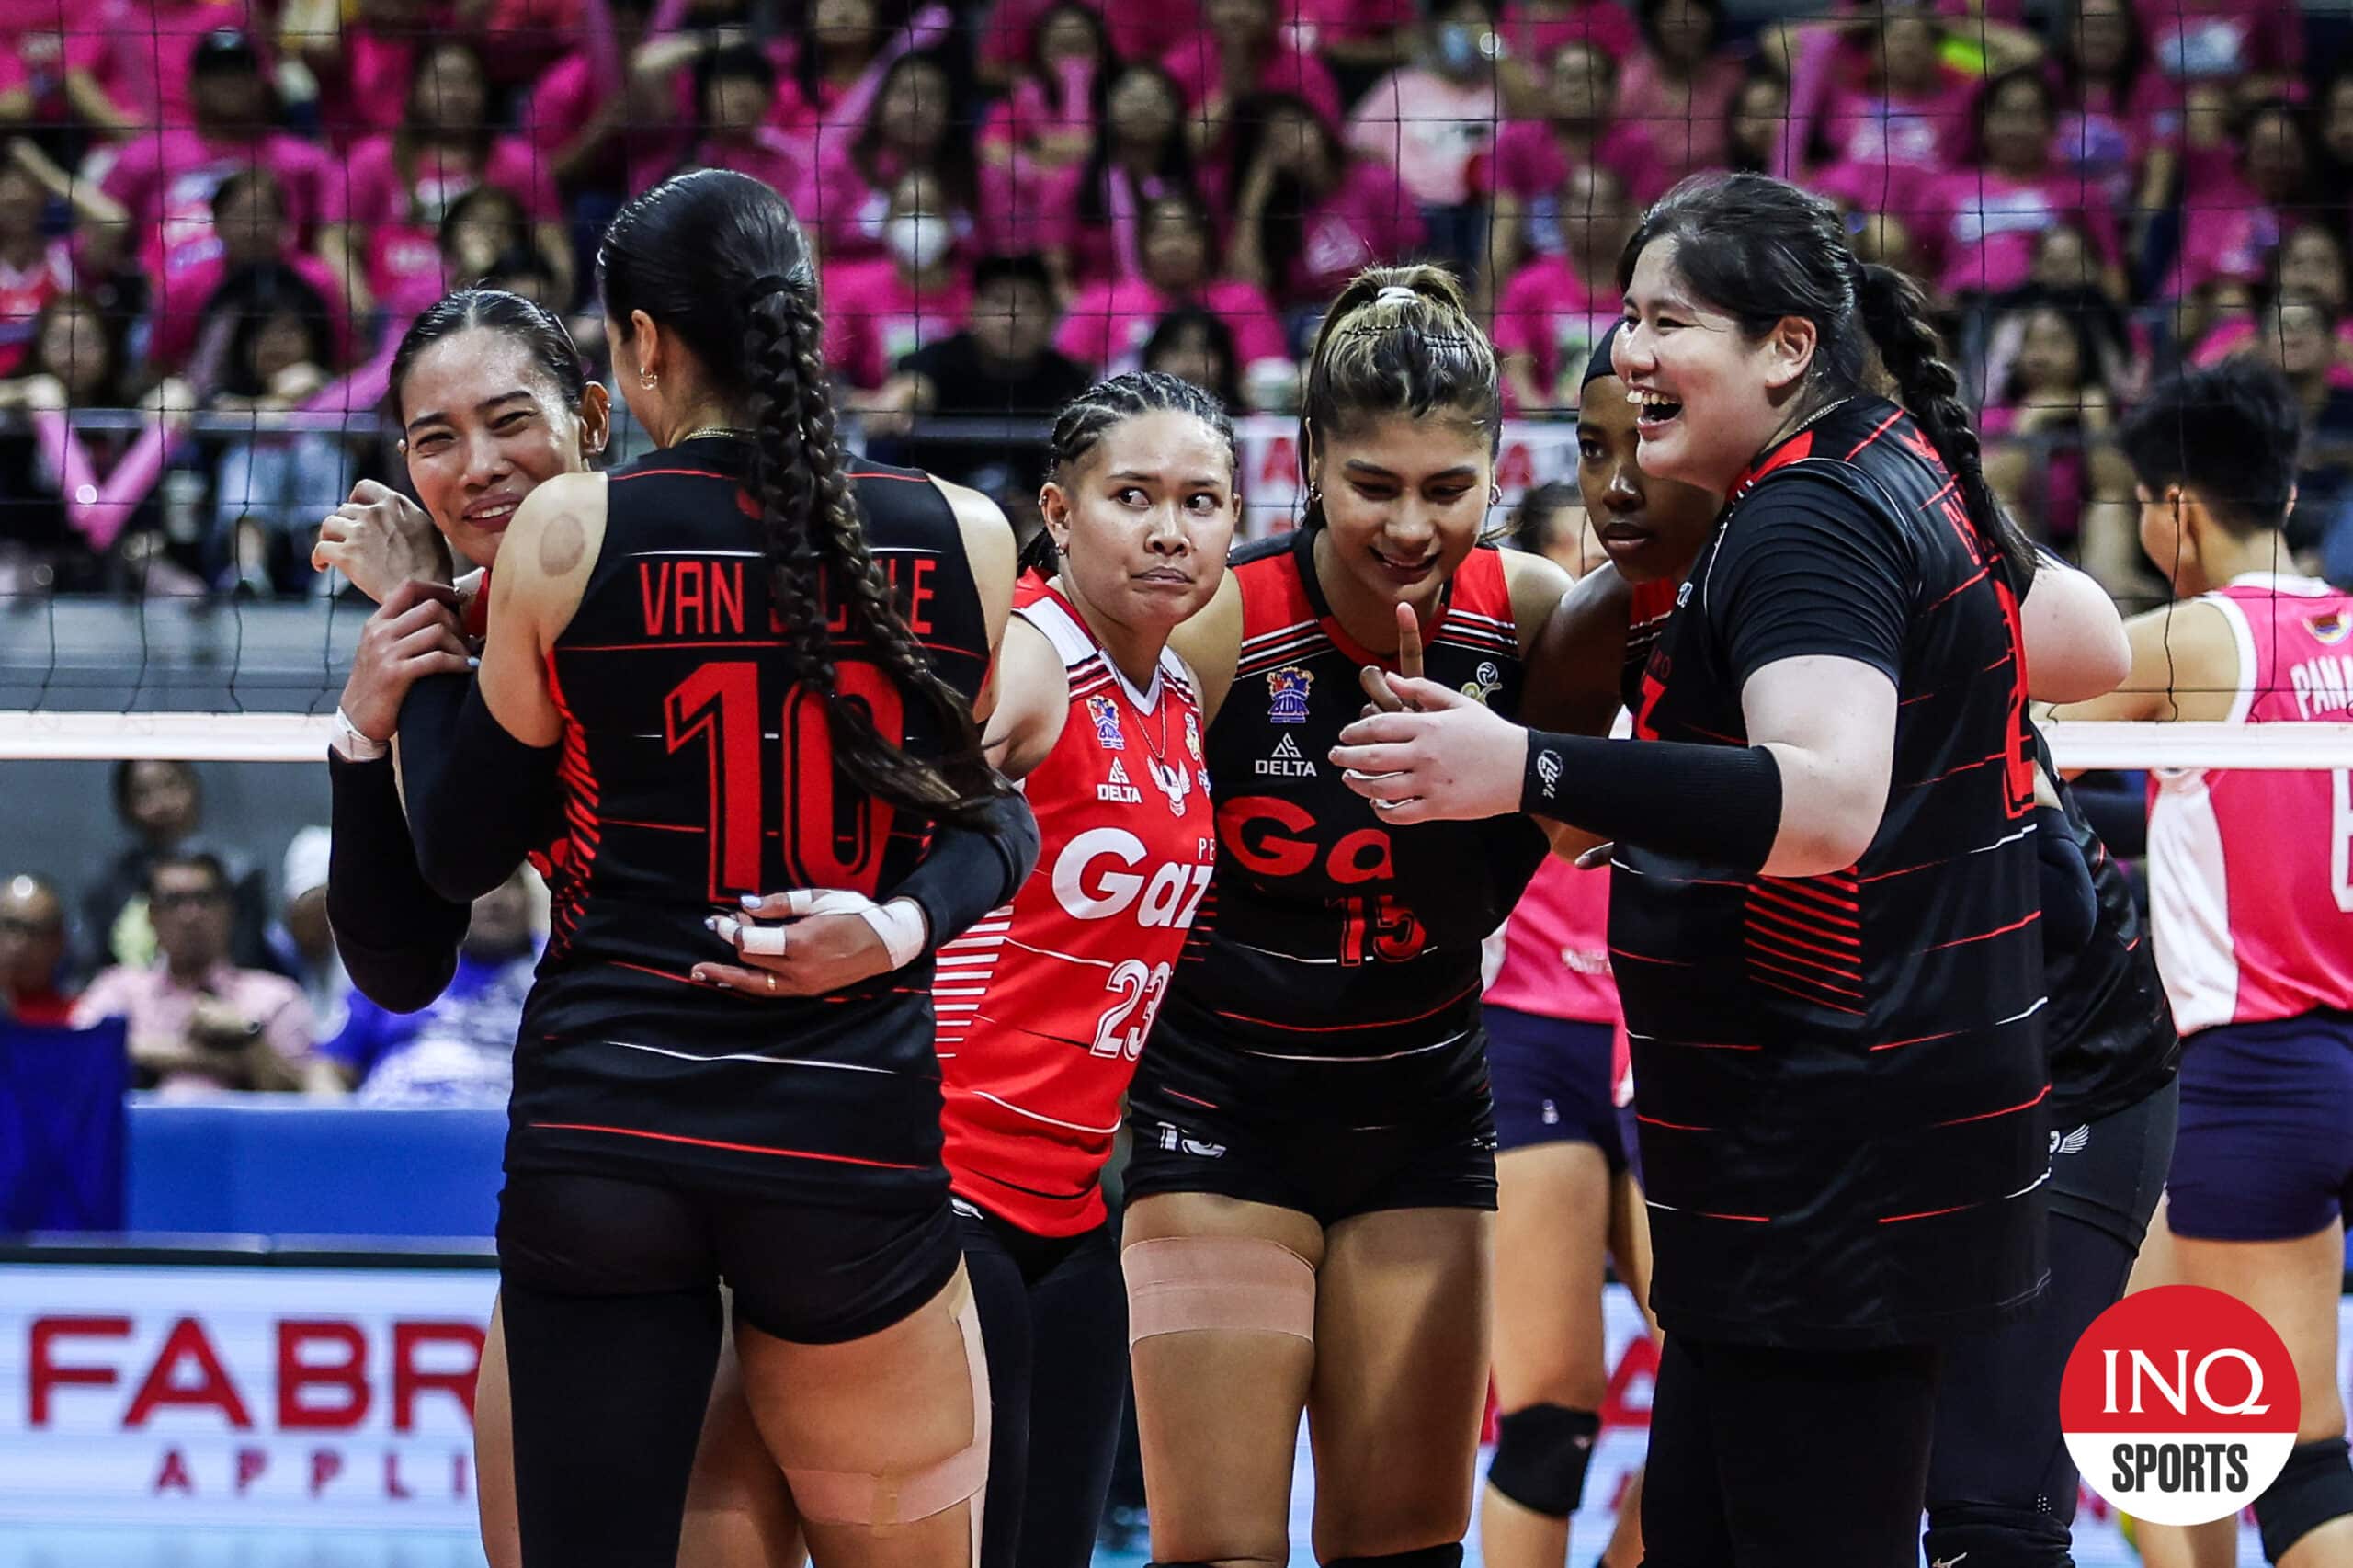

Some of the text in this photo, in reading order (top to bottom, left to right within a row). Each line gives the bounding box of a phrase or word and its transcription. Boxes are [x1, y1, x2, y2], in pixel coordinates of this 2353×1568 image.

[640, 561, 745, 635] VAN
[664, 660, 904, 902] 10
[1097, 784, 1142, 803] DELTA
[1255, 759, 1317, 777] DELTA
[1325, 895, 1427, 965] 15
[1090, 960, 1170, 1062] 23
[29, 1315, 488, 1432] FABR
[154, 1448, 468, 1498] APPLI
